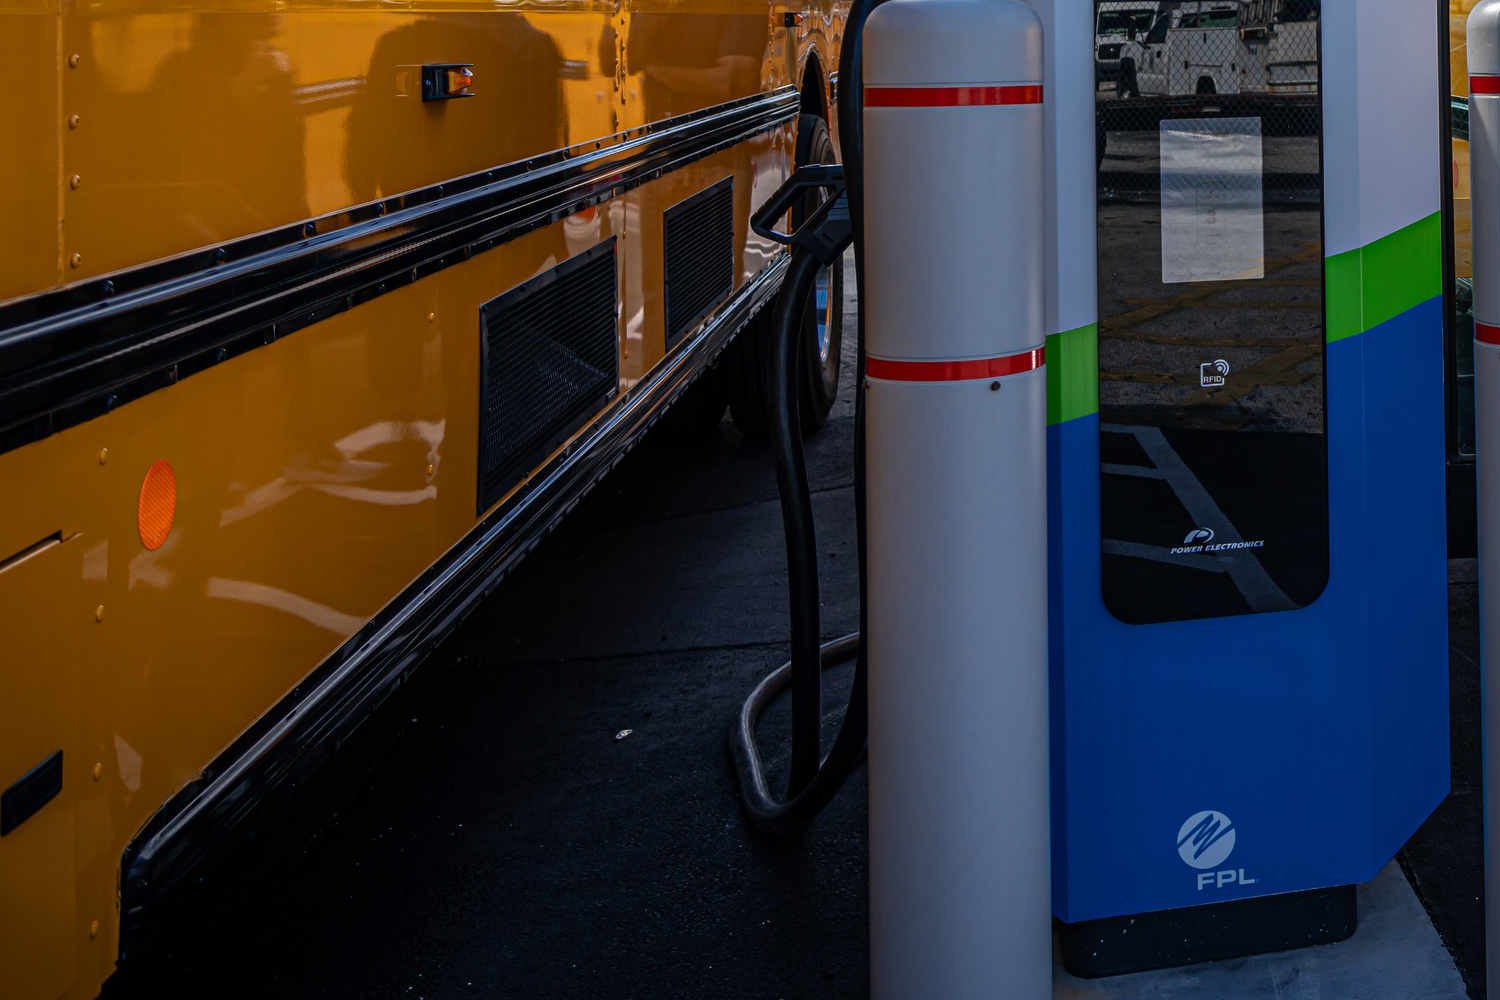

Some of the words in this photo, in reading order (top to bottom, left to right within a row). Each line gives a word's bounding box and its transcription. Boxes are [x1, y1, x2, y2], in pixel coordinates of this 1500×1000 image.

[1202, 375, 1223, 384] RFID
[1170, 545, 1203, 555] POWER
[1204, 539, 1265, 553] ELECTRONICS
[1196, 868, 1256, 890] FPL
